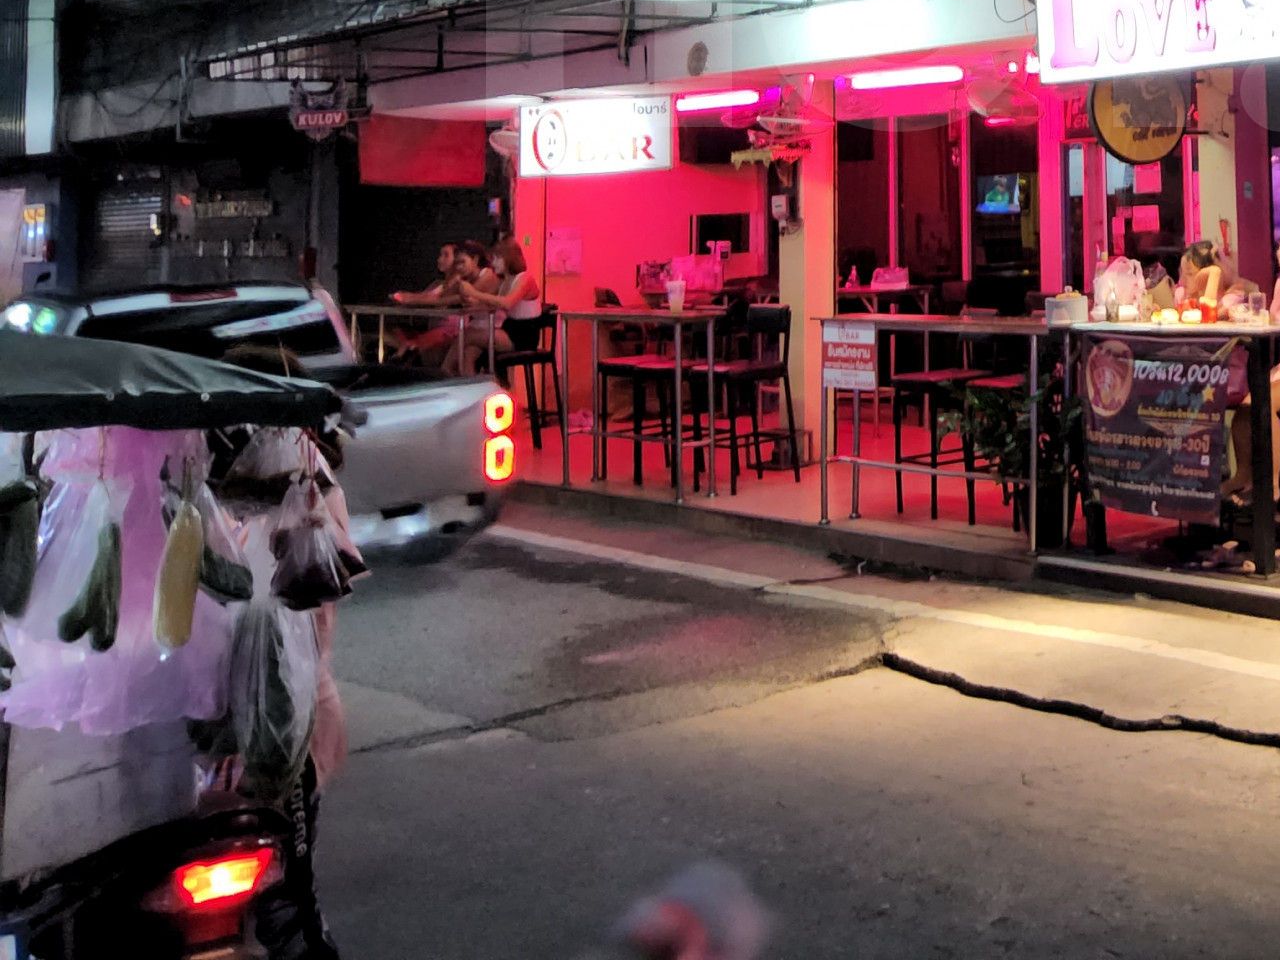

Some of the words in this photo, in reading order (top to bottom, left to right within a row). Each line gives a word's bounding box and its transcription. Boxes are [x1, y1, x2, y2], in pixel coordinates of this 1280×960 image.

[632, 100, 668, 116] โอบาร์
[298, 111, 343, 127] KULOV
